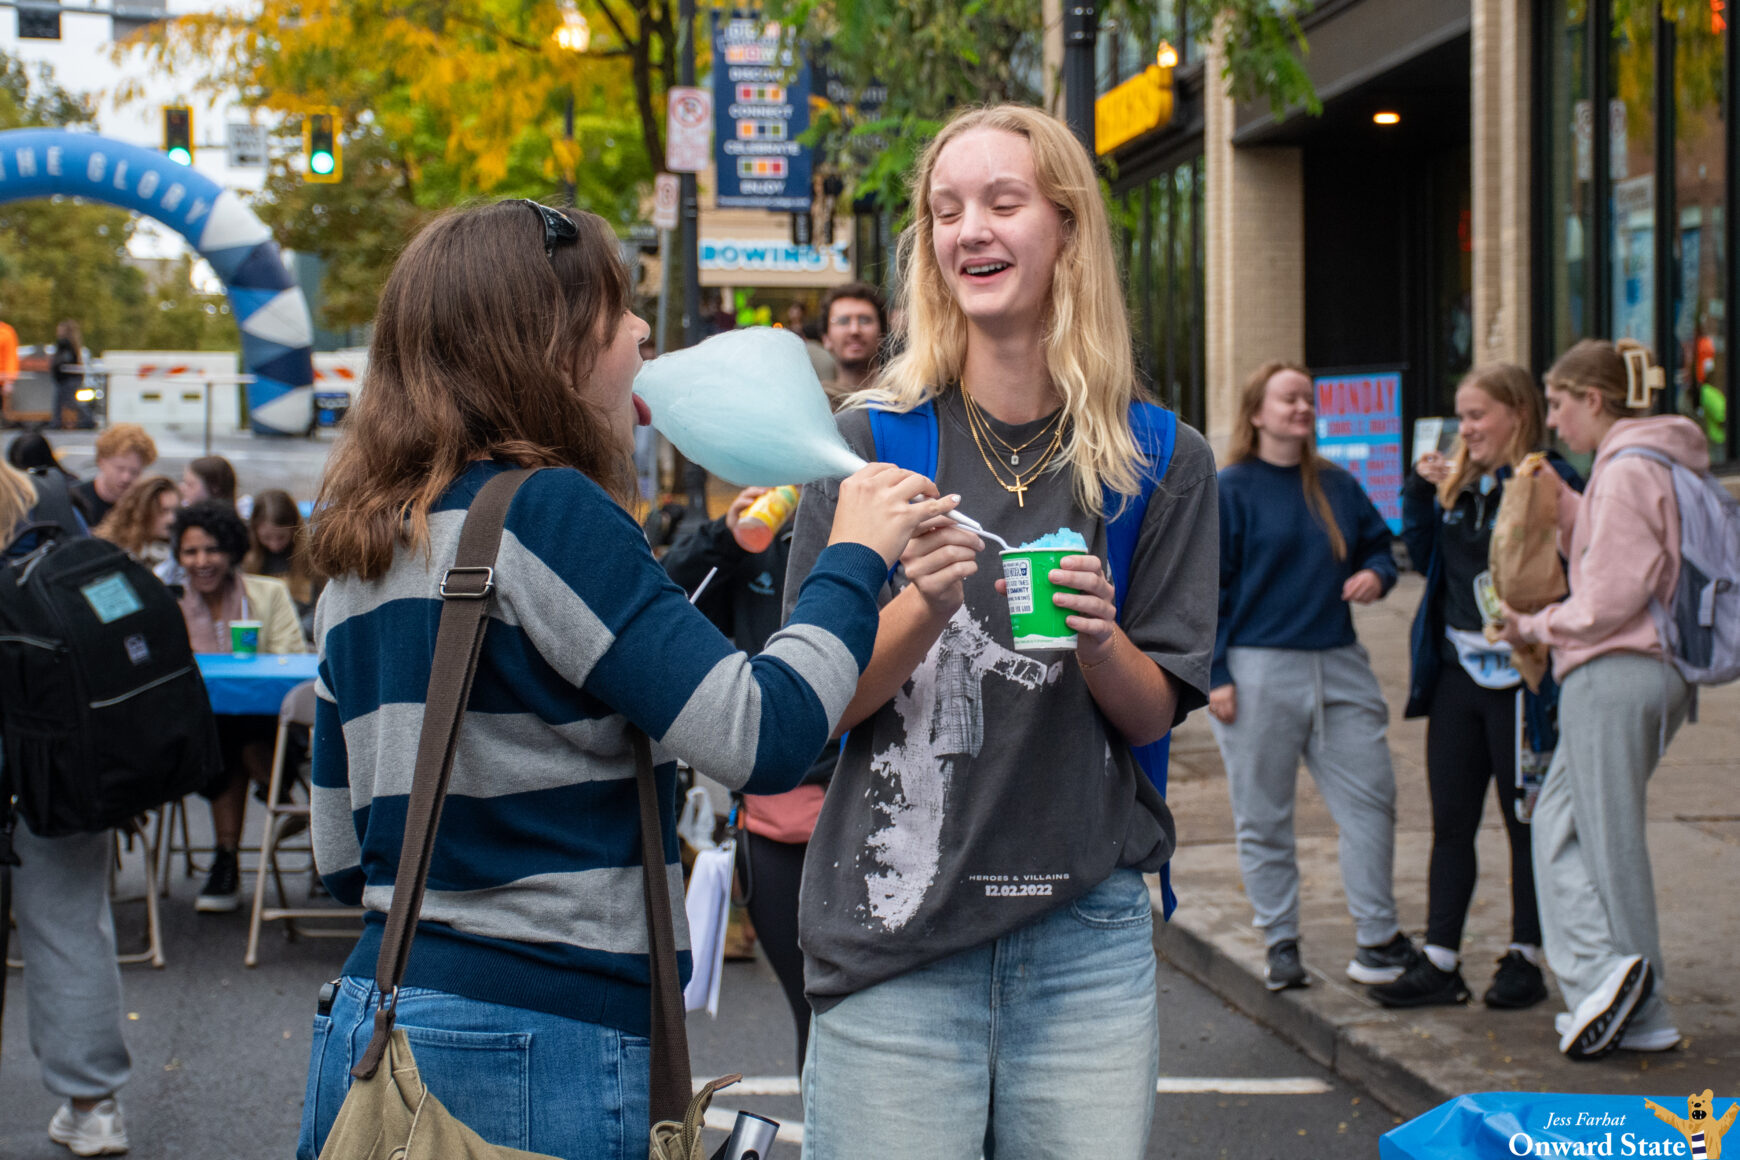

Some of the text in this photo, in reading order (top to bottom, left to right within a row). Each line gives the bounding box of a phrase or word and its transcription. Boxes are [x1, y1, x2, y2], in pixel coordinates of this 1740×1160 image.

[728, 104, 793, 119] CONNECT
[723, 140, 800, 156] CELEBRATE
[87, 151, 210, 225] GLORY
[740, 180, 786, 195] ENJOY
[1317, 380, 1397, 416] MONDAY
[969, 874, 1009, 882] HEROES
[1023, 873, 1070, 881] VILLAINS
[985, 884, 1053, 897] 12.02.2022
